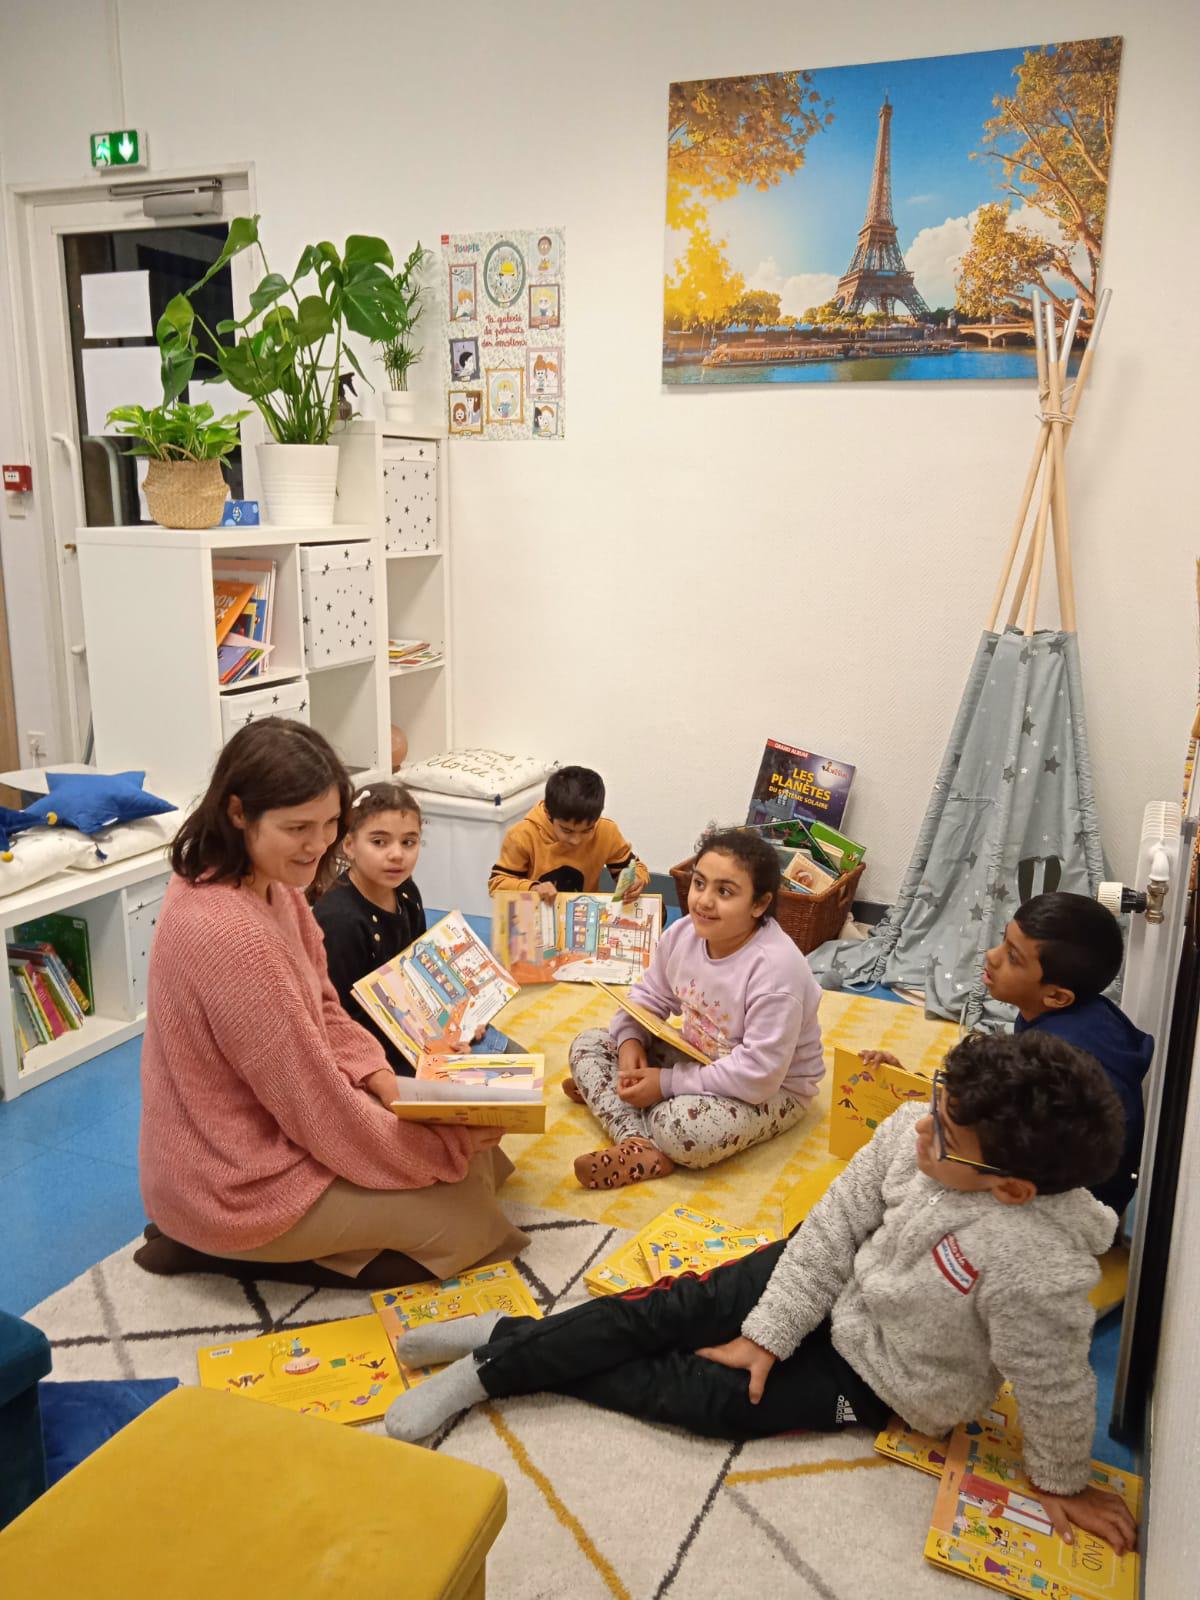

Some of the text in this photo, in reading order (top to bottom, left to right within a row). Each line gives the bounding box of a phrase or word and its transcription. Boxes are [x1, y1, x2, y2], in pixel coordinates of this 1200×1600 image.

[484, 326, 492, 334] de
[481, 339, 492, 347] des
[793, 768, 814, 783] LES
[769, 786, 778, 794] DU
[804, 797, 828, 810] SOLAIRE
[835, 1395, 845, 1424] adidas
